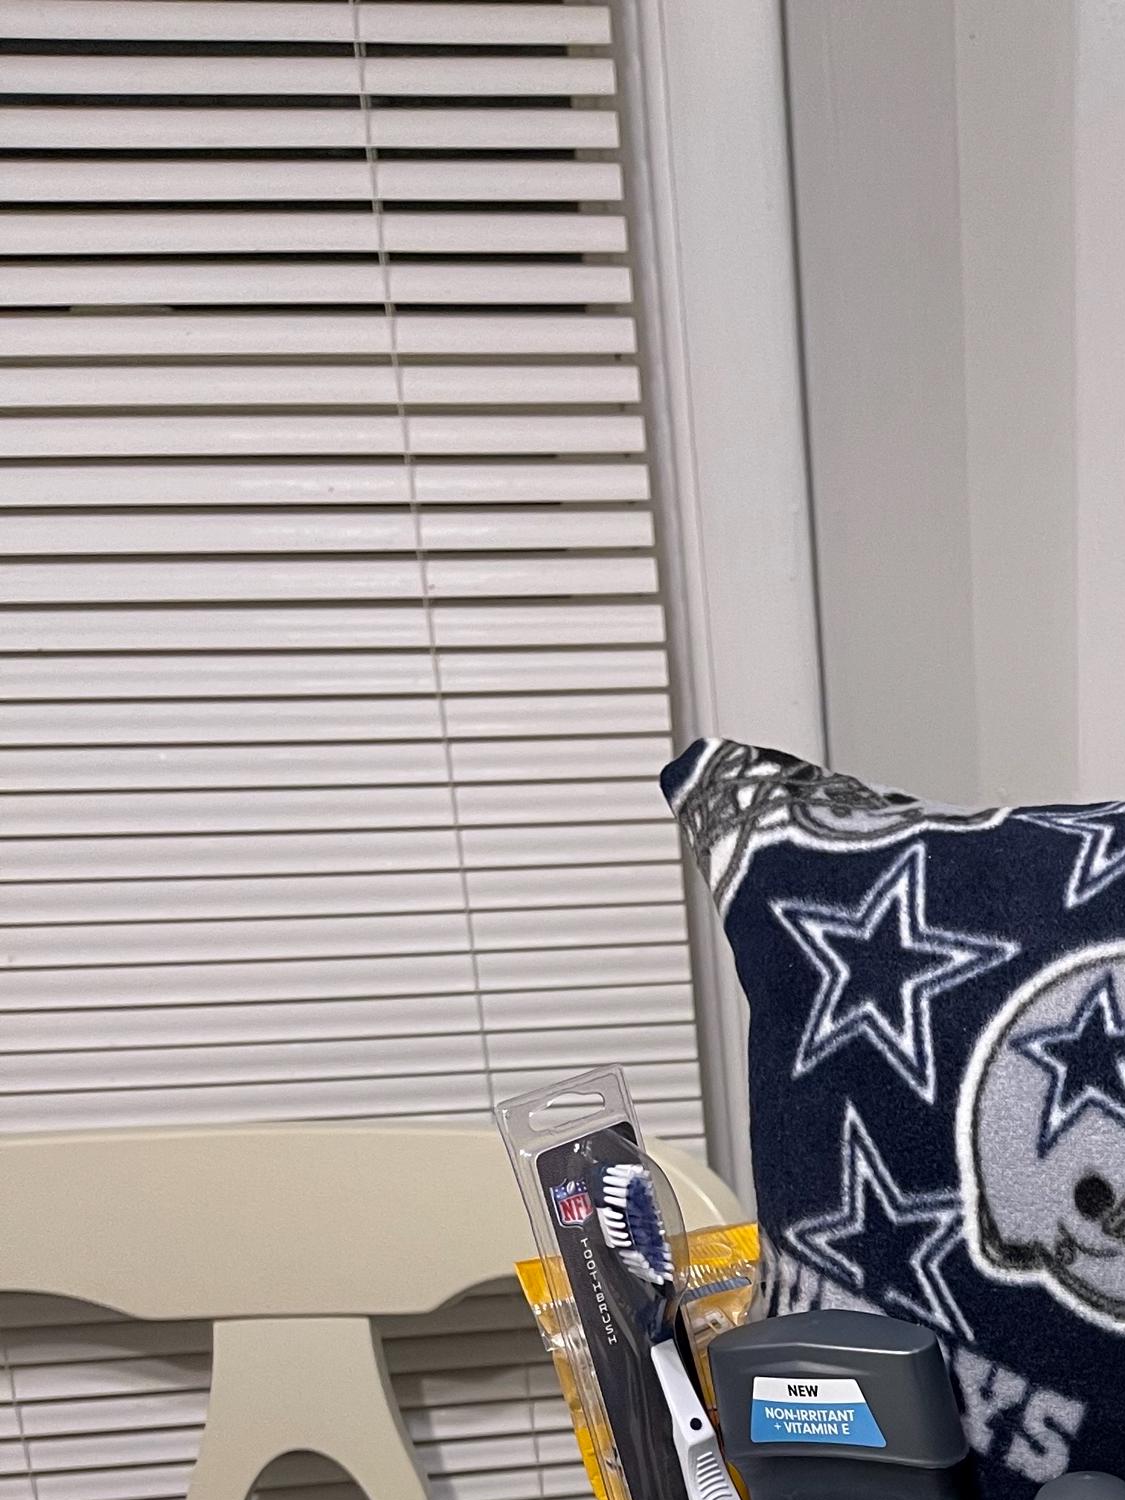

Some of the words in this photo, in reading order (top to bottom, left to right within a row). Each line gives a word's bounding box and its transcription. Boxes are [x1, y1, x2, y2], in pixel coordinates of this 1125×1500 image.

[559, 1197, 594, 1222] NFL
[580, 1237, 618, 1345] TOOTHBRUSH
[787, 1384, 819, 1398] NEW
[764, 1406, 855, 1422] NON-IRRITANT
[783, 1422, 839, 1435] VITAMIN
[842, 1423, 851, 1435] E
